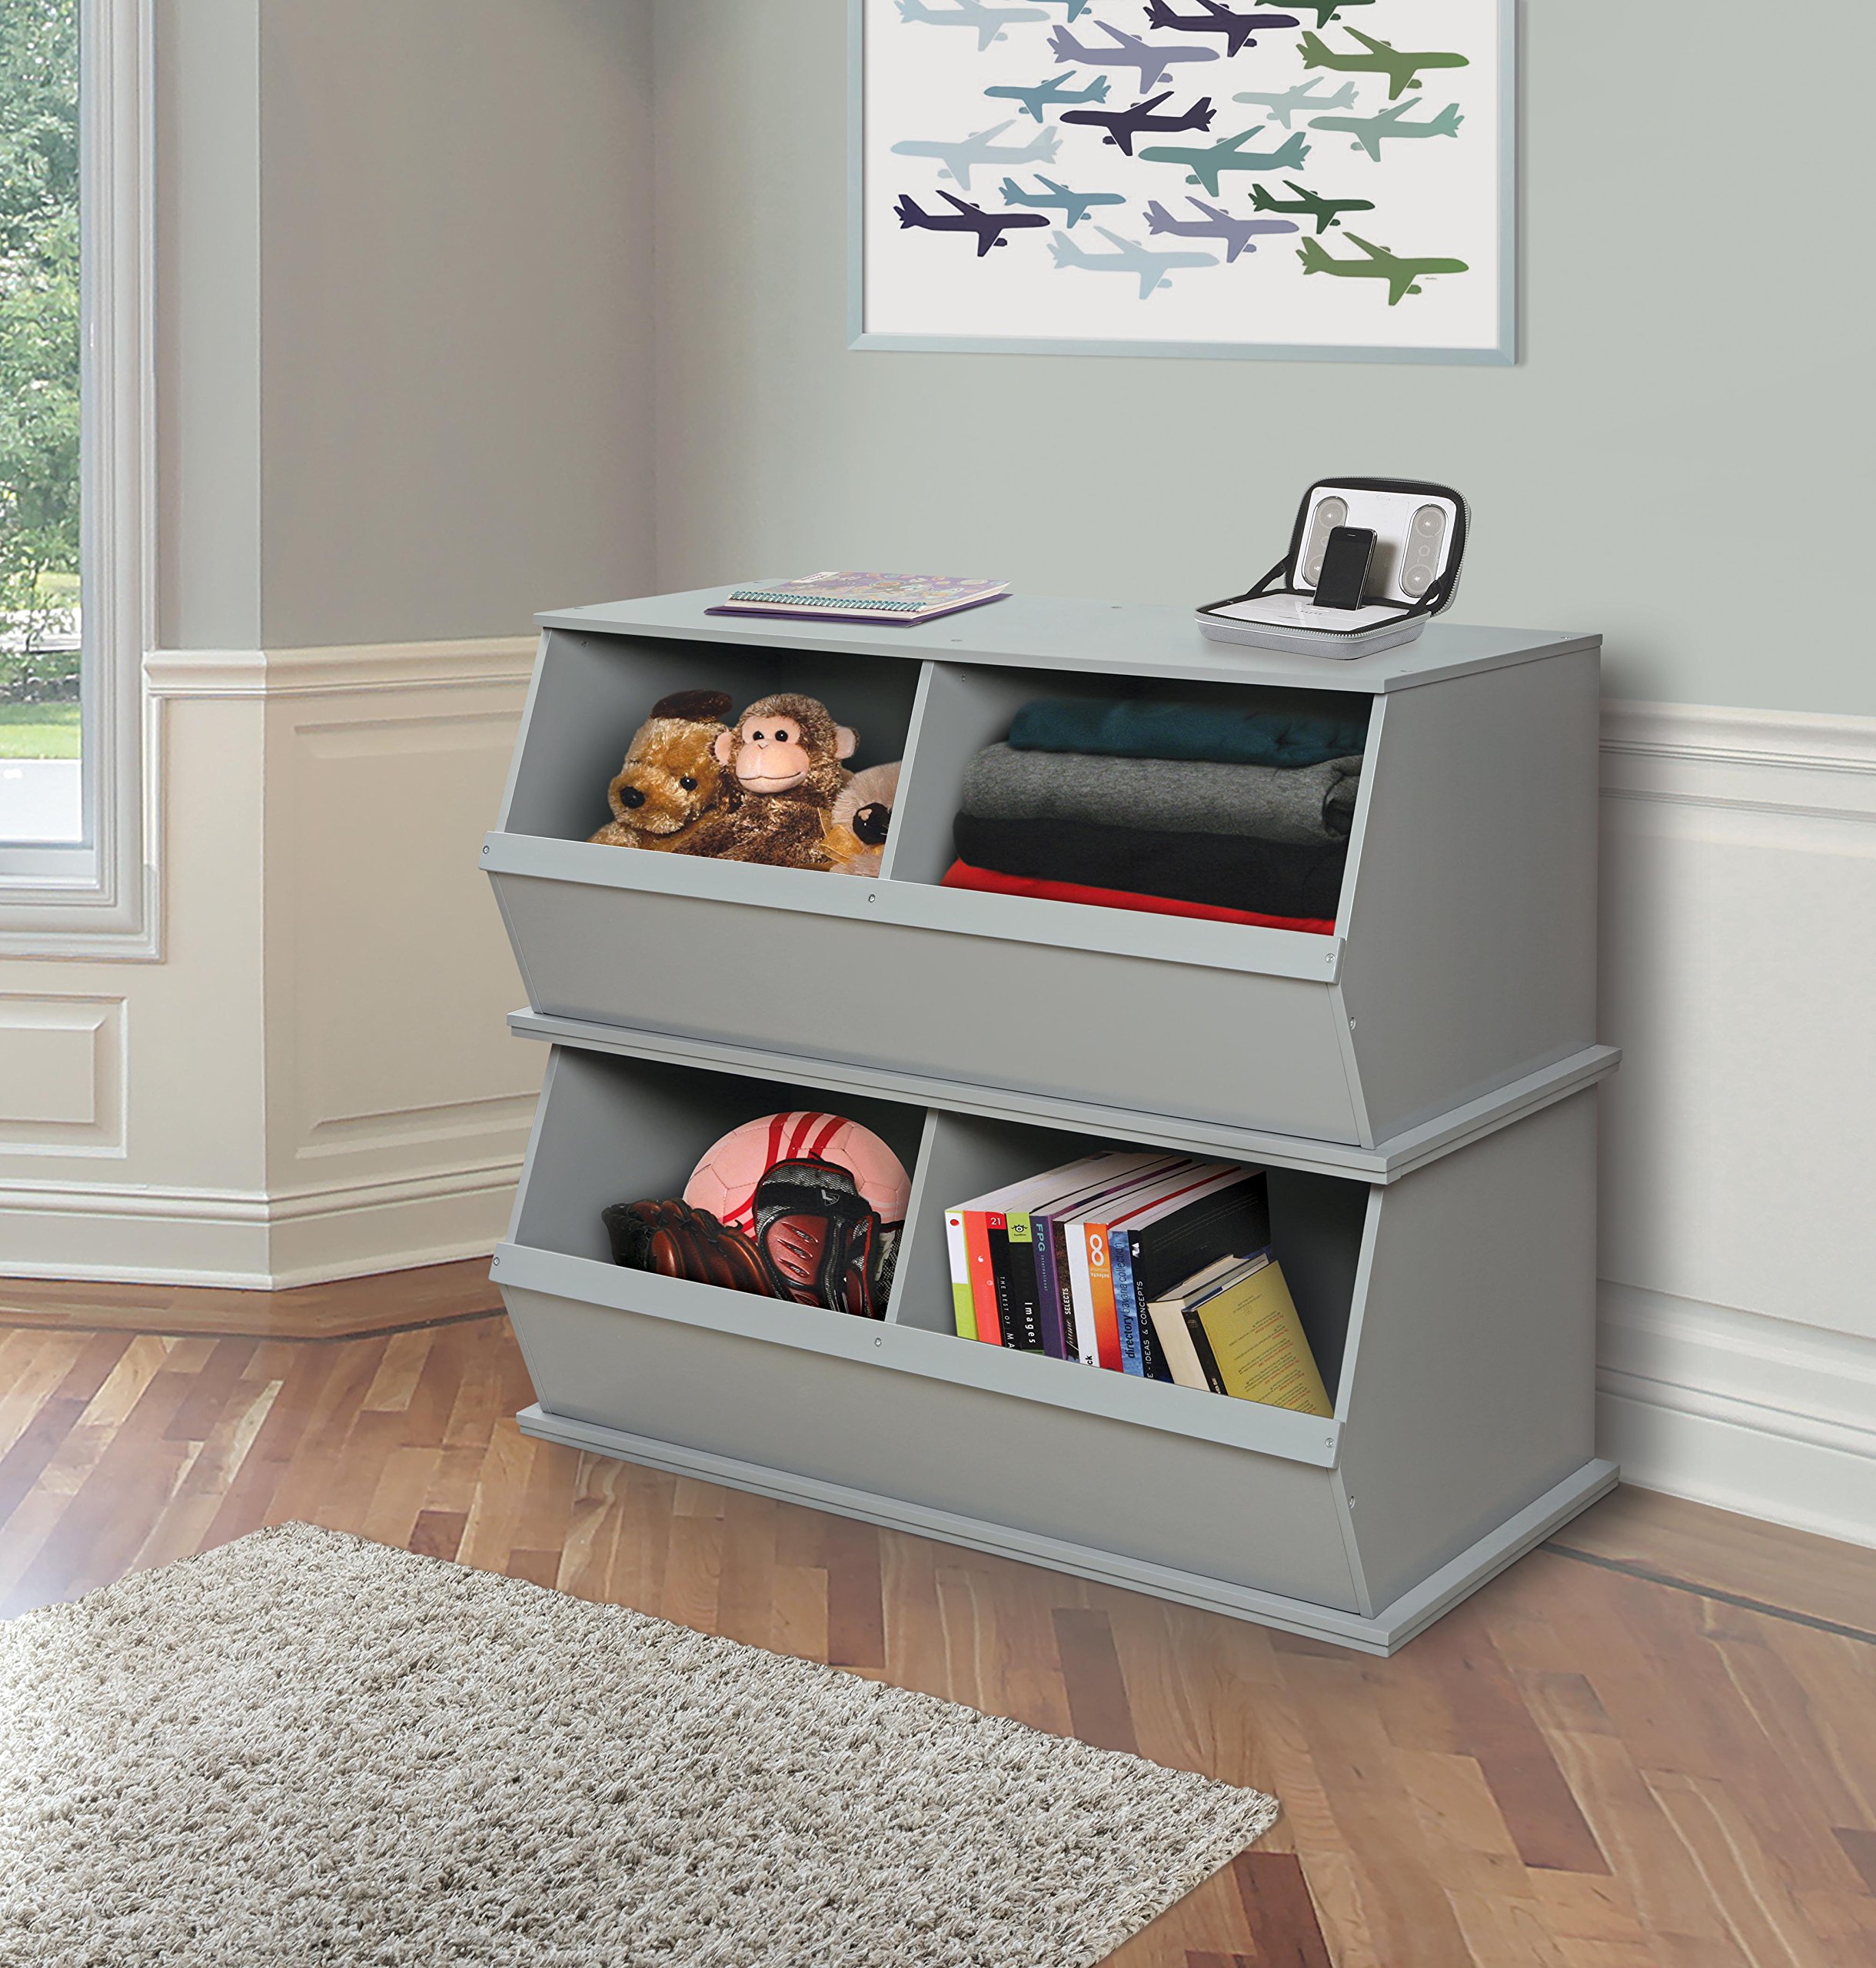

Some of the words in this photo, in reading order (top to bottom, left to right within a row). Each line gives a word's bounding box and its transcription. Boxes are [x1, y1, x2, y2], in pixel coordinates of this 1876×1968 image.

[990, 1217, 1001, 1225] 21
[1036, 1223, 1046, 1252] FPG
[1089, 1234, 1105, 1267] 8
[1114, 1242, 1127, 1282] collection
[1062, 1288, 1071, 1315] SELECTS
[1136, 1281, 1148, 1325] CONCEPTS
[1004, 1315, 1010, 1325] OF
[1024, 1302, 1036, 1343] Images
[1123, 1315, 1136, 1358] directory
[1143, 1339, 1152, 1365] IDEAS
